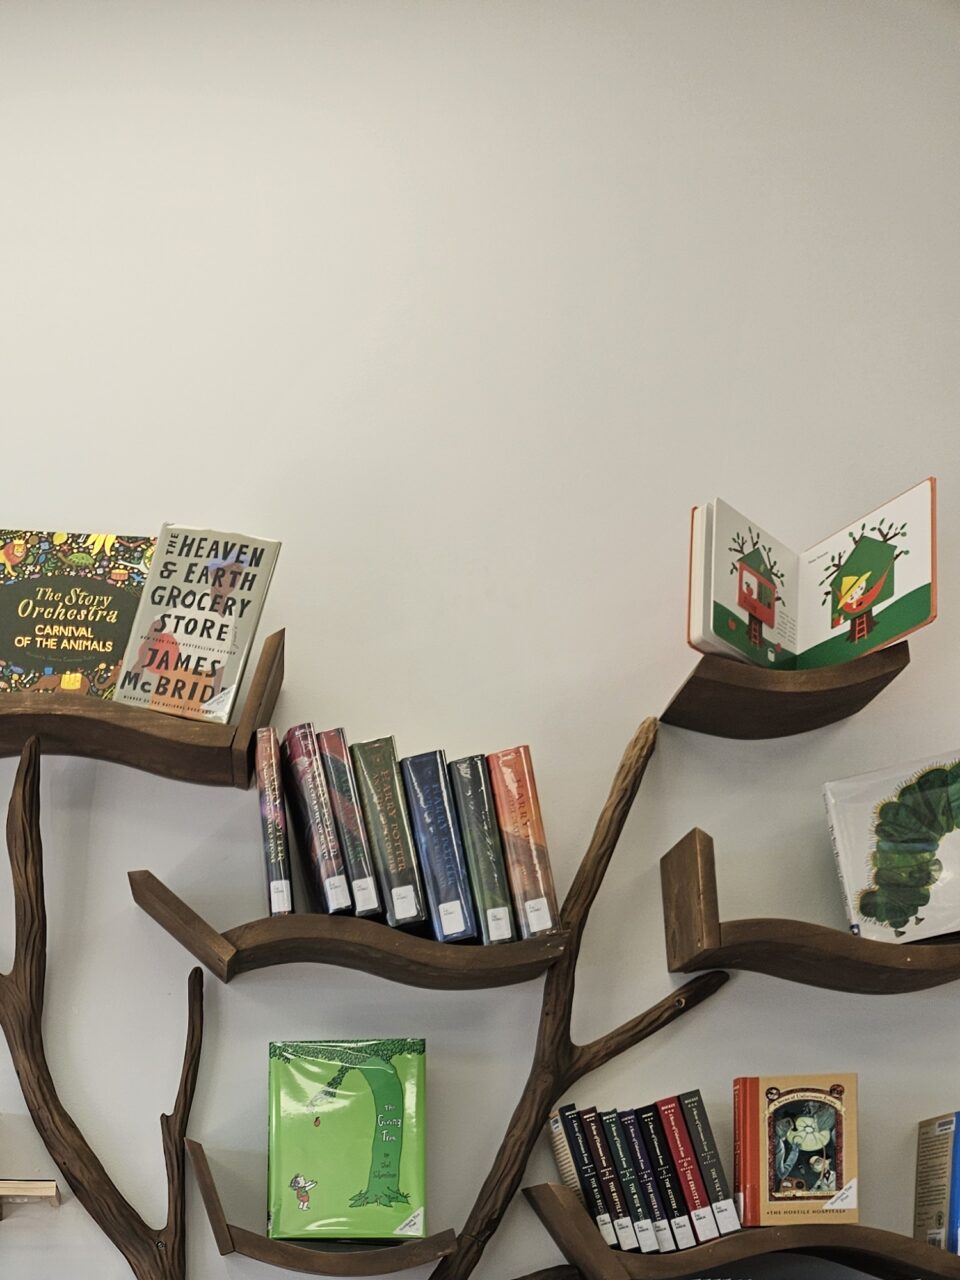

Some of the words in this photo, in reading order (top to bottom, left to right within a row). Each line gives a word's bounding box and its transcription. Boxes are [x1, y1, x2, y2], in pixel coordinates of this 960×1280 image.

[166, 532, 179, 555] THE
[178, 535, 265, 568] HEAVEN
[160, 561, 177, 579] &
[184, 563, 256, 591] EARTH
[18, 599, 118, 623] Orchestra
[36, 587, 61, 600] The
[65, 588, 112, 609] Story
[151, 586, 251, 618] GROCERY
[35, 625, 94, 637] CARNIVAL
[154, 614, 229, 642] STORE
[15, 637, 31, 647] OF
[35, 638, 58, 649] THE
[61, 639, 112, 652] ANIMALS
[142, 648, 221, 678] JAMES
[120, 671, 228, 703] McBRID
